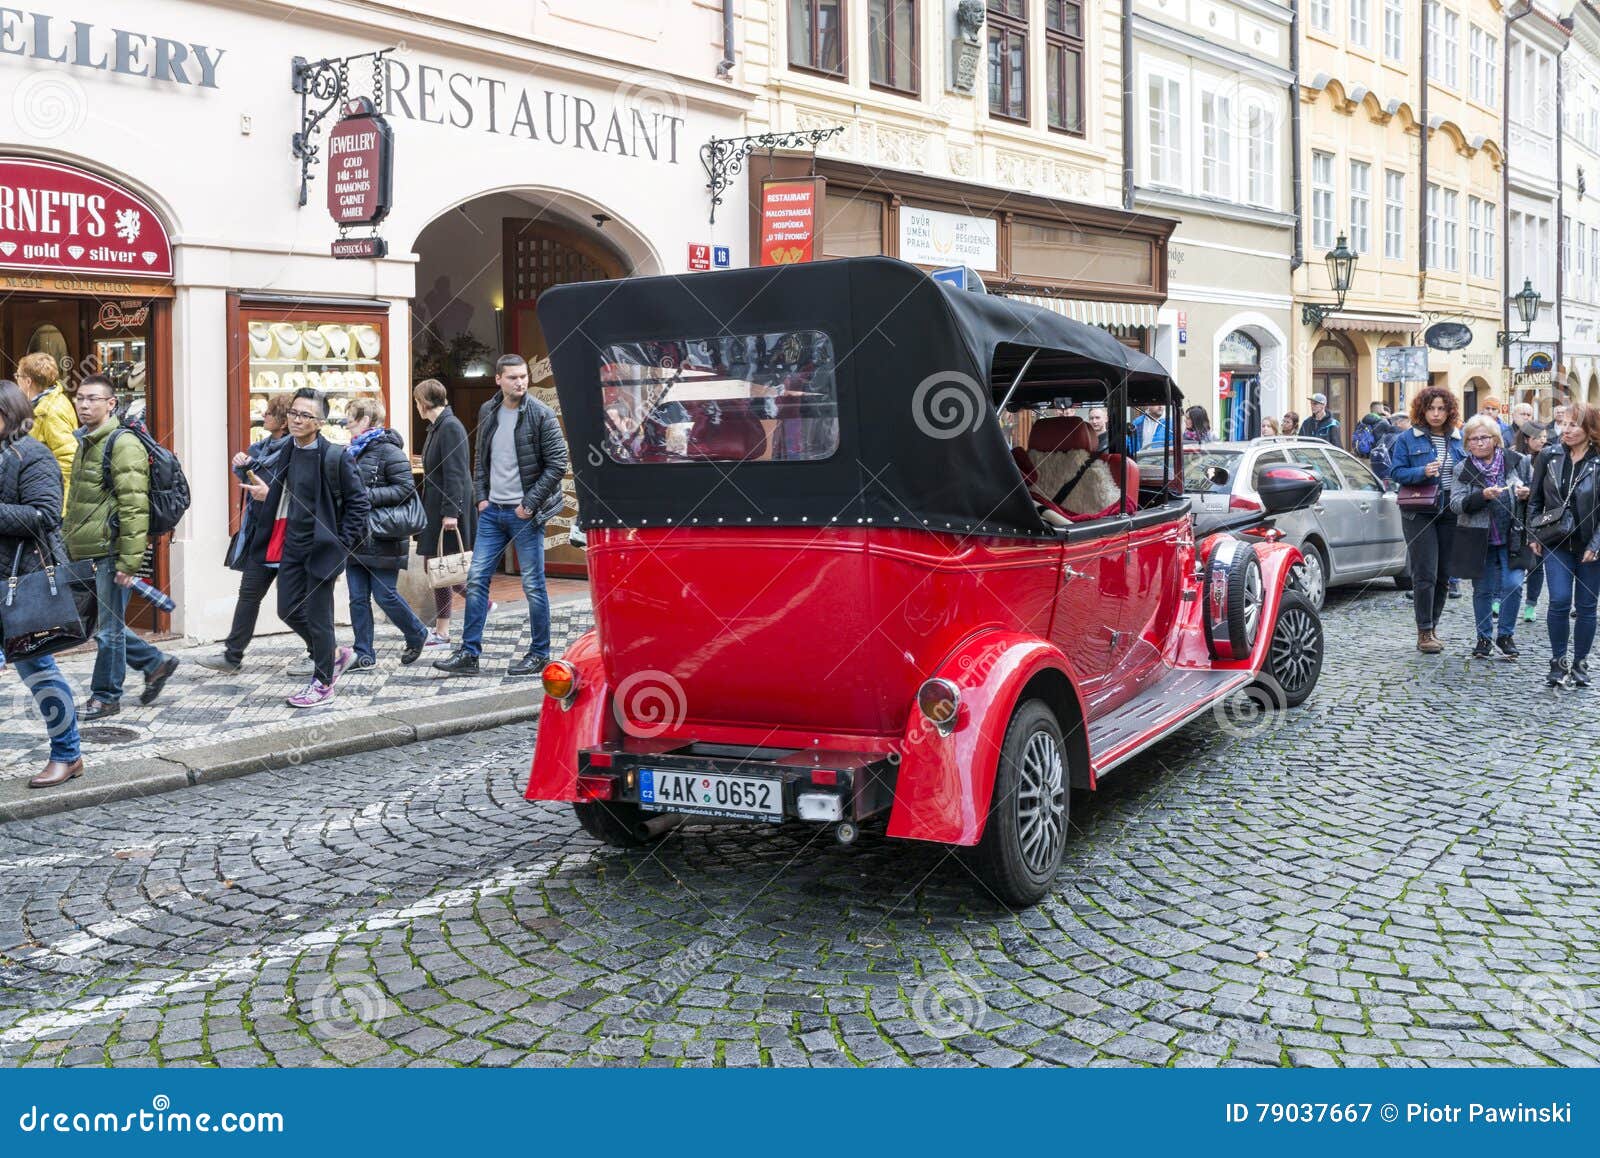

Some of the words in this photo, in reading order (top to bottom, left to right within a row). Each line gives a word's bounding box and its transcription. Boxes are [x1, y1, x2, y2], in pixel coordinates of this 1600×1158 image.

[0, 7, 226, 89] ELLERY
[381, 57, 685, 164] RESTAURANT
[330, 132, 376, 158] JEWELLERY
[343, 156, 363, 169] GOLD
[335, 181, 370, 193] DIAMONDS
[339, 194, 365, 205] GARNET
[767, 192, 811, 202] RESTAURANT
[0, 186, 106, 237] RNETS
[341, 206, 363, 218] AMBER
[955, 223, 968, 231] ART
[906, 237, 930, 249] PRAHA
[23, 242, 60, 259] gold
[89, 246, 137, 263] silver
[642, 790, 653, 799] CZ
[659, 775, 698, 803] 4AK
[715, 779, 772, 809] 0652
